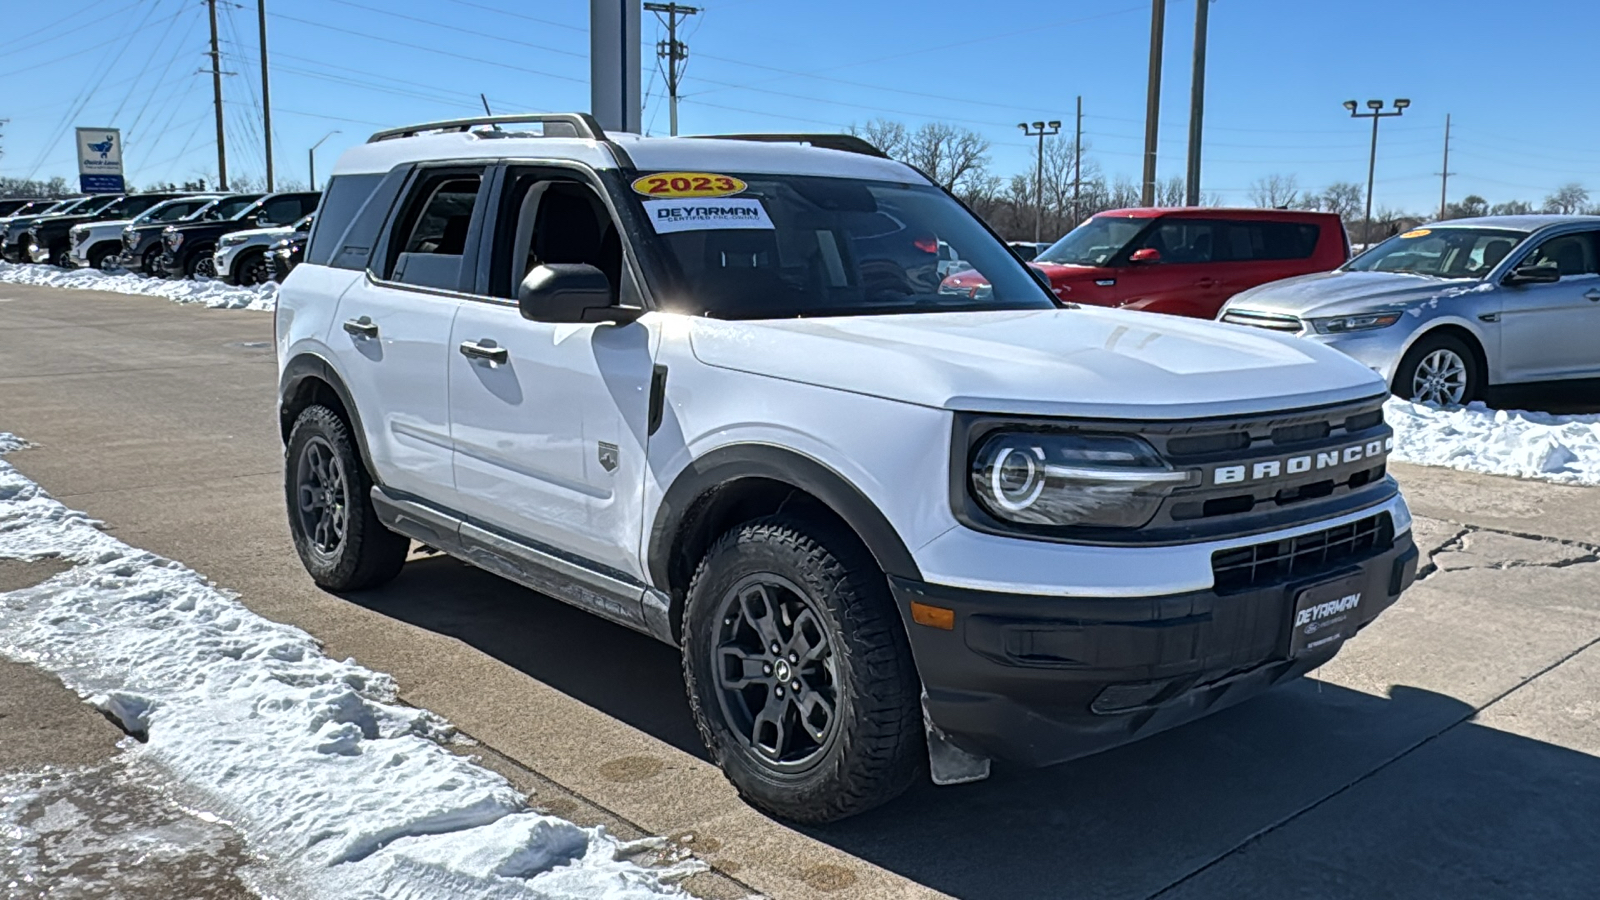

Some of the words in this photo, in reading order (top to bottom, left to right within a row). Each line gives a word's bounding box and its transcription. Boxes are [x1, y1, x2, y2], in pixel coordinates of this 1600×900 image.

[648, 178, 736, 194] 2023
[658, 206, 759, 218] DEYARMAN
[1214, 441, 1381, 485] BRONCO
[1295, 592, 1361, 627] DEYARMAN
